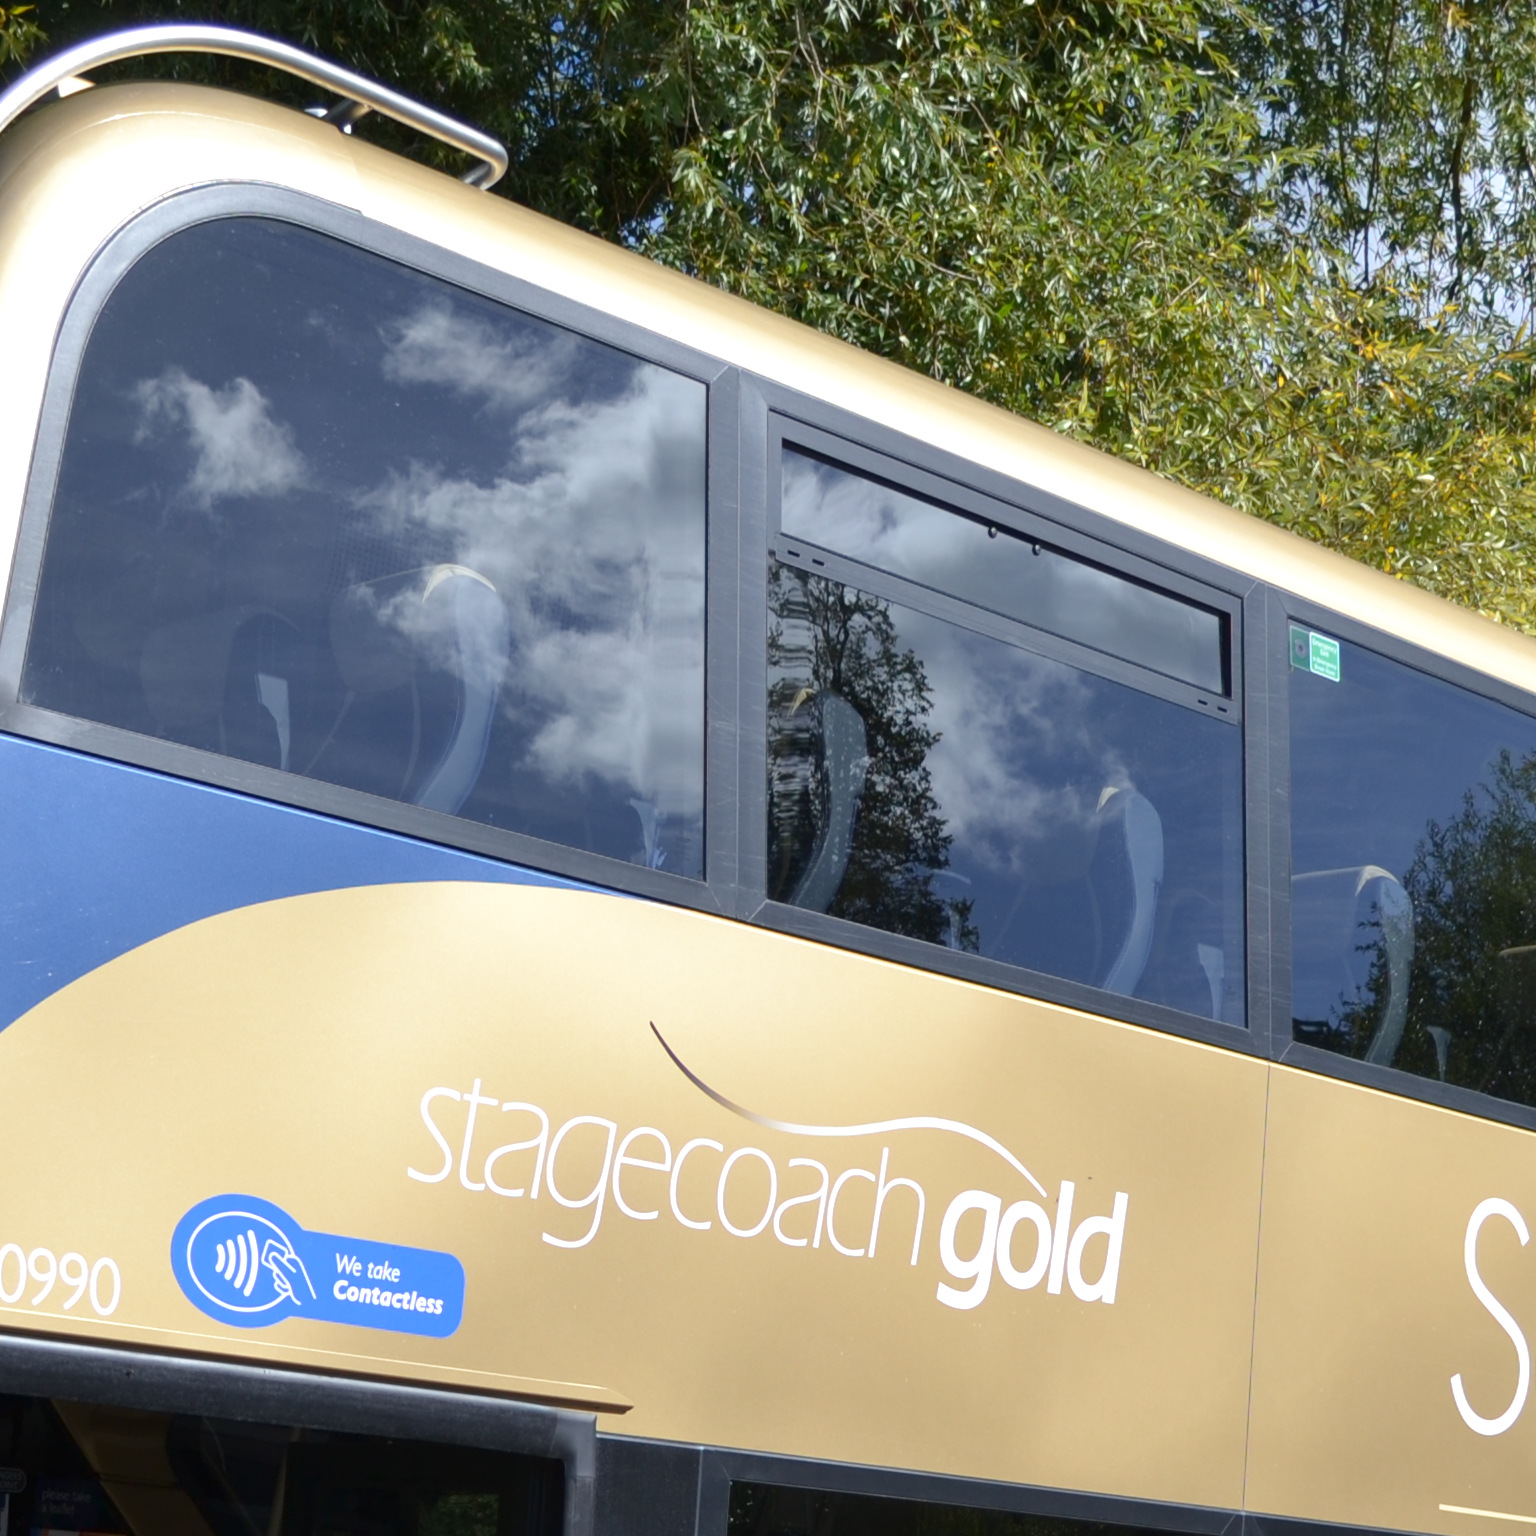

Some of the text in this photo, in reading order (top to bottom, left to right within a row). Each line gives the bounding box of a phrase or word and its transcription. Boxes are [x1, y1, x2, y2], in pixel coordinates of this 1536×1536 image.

[407, 1078, 1129, 1310] stagecoach gold
[335, 1252, 401, 1282] We take
[332, 1280, 445, 1315] Contactless
